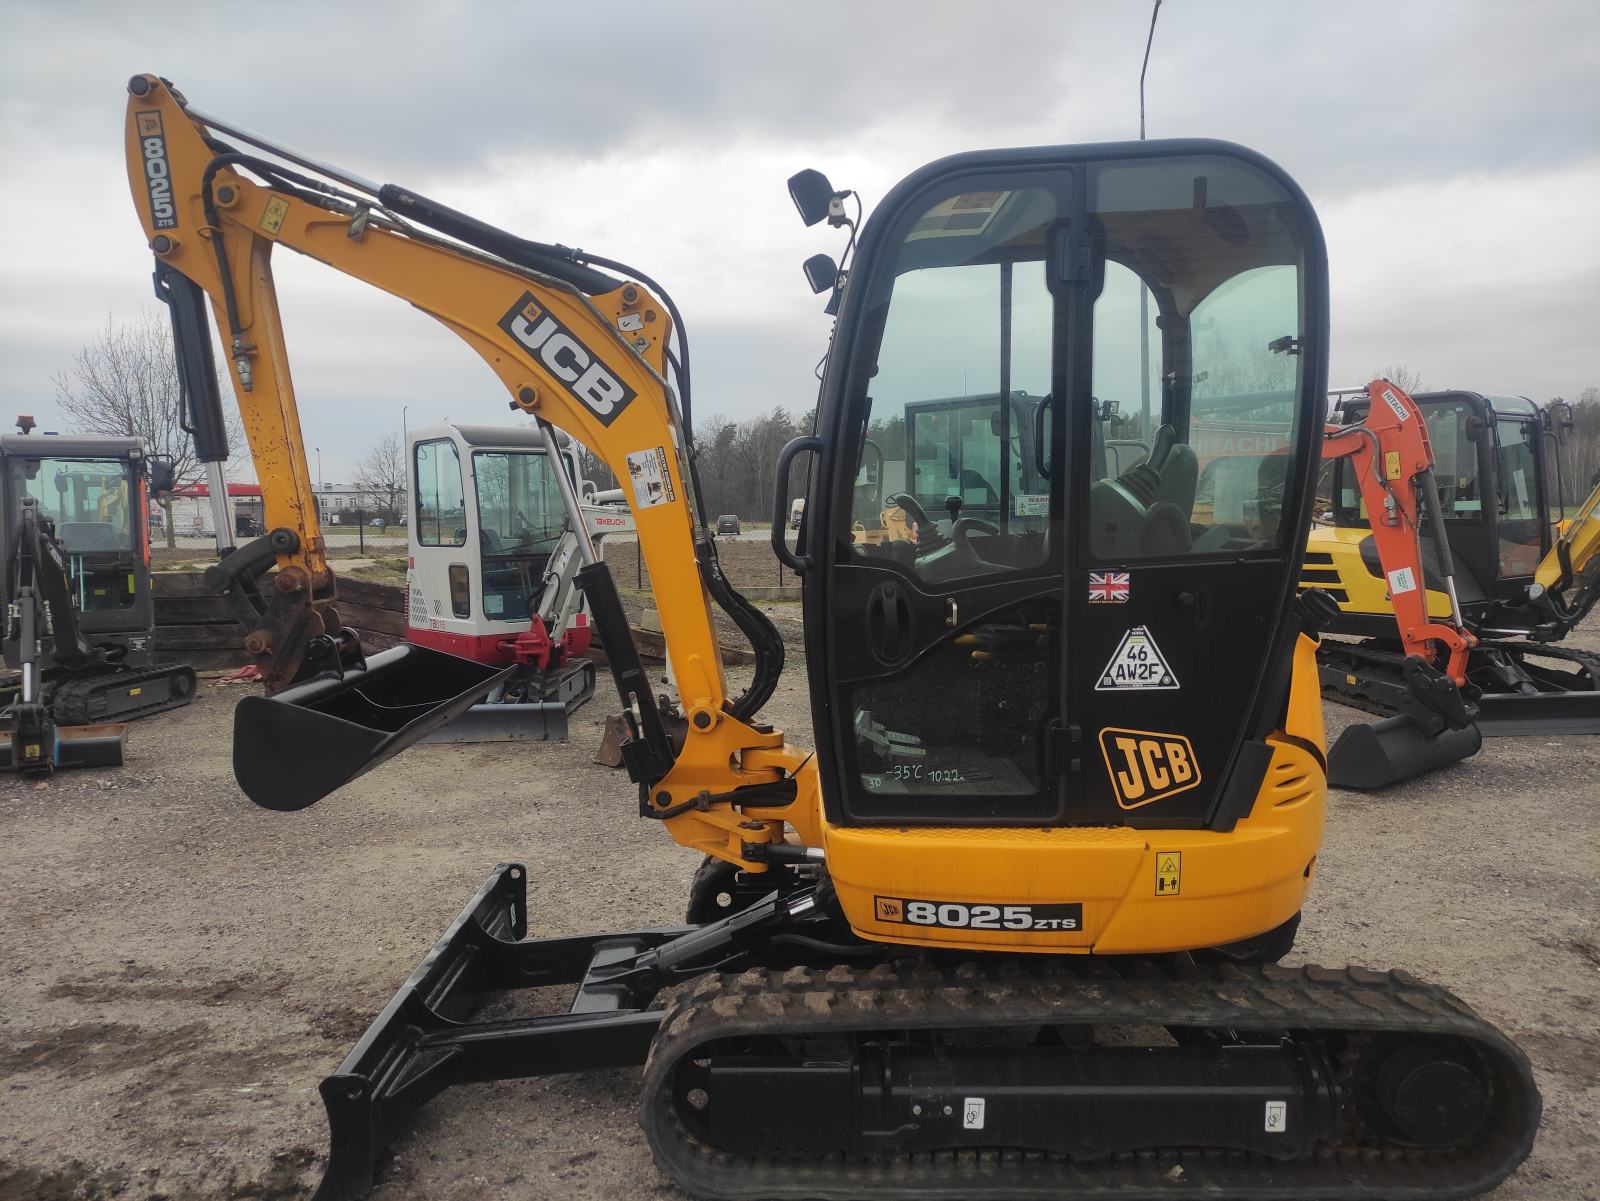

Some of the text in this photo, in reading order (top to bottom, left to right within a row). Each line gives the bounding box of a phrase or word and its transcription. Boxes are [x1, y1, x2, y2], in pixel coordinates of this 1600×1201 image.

[143, 137, 173, 218] 8025
[157, 218, 174, 227] ZTS
[510, 312, 625, 416] JCB
[1384, 391, 1409, 420] HITACHI
[1195, 437, 1278, 453] ITACHI
[1127, 645, 1148, 662] 46
[1115, 663, 1160, 681] AW2F
[1115, 736, 1192, 800] JCB
[907, 902, 1033, 929] 8025
[1034, 918, 1077, 929] ZTS
